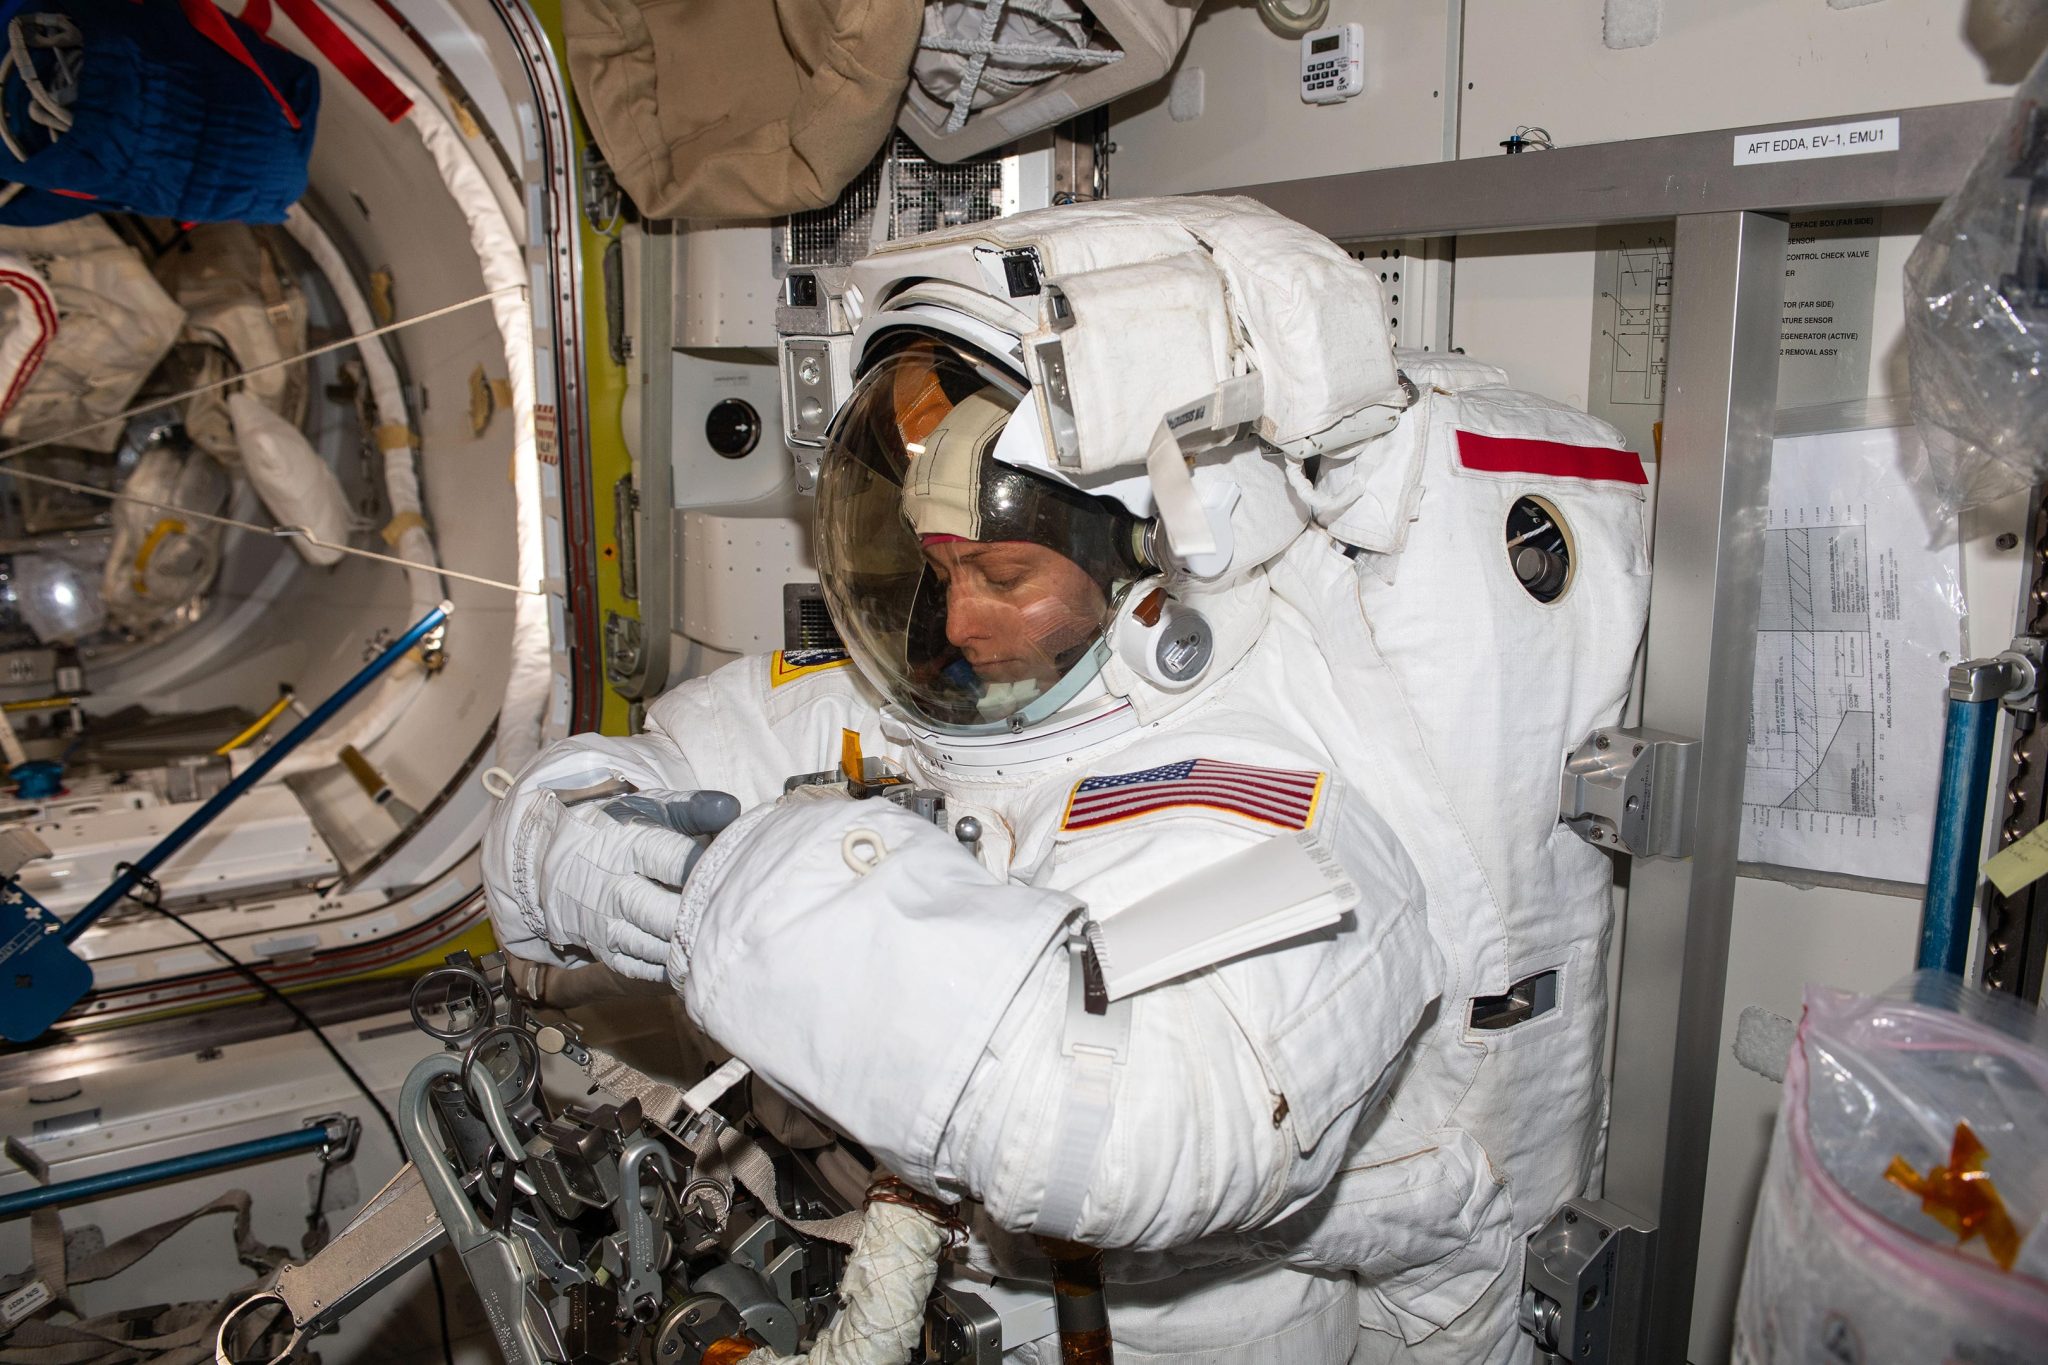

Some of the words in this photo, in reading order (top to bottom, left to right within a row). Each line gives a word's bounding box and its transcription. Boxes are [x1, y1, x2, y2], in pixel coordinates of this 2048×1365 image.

[1748, 141, 1770, 154] AFT
[1773, 137, 1808, 152] EDDA,
[1812, 134, 1846, 148] EV-1,
[1849, 129, 1884, 144] EMU1
[1789, 221, 1817, 229] ERFACE
[1786, 253, 1819, 261] CONTROL
[1821, 252, 1845, 260] CHECK
[1847, 250, 1870, 258] VALVE
[1798, 301, 1814, 309] (FAR
[1816, 300, 1834, 308] SIDE)
[1804, 316, 1833, 324] SENSOR
[1828, 332, 1858, 341] (ACTIVE)
[1819, 348, 1838, 356] ASSY
